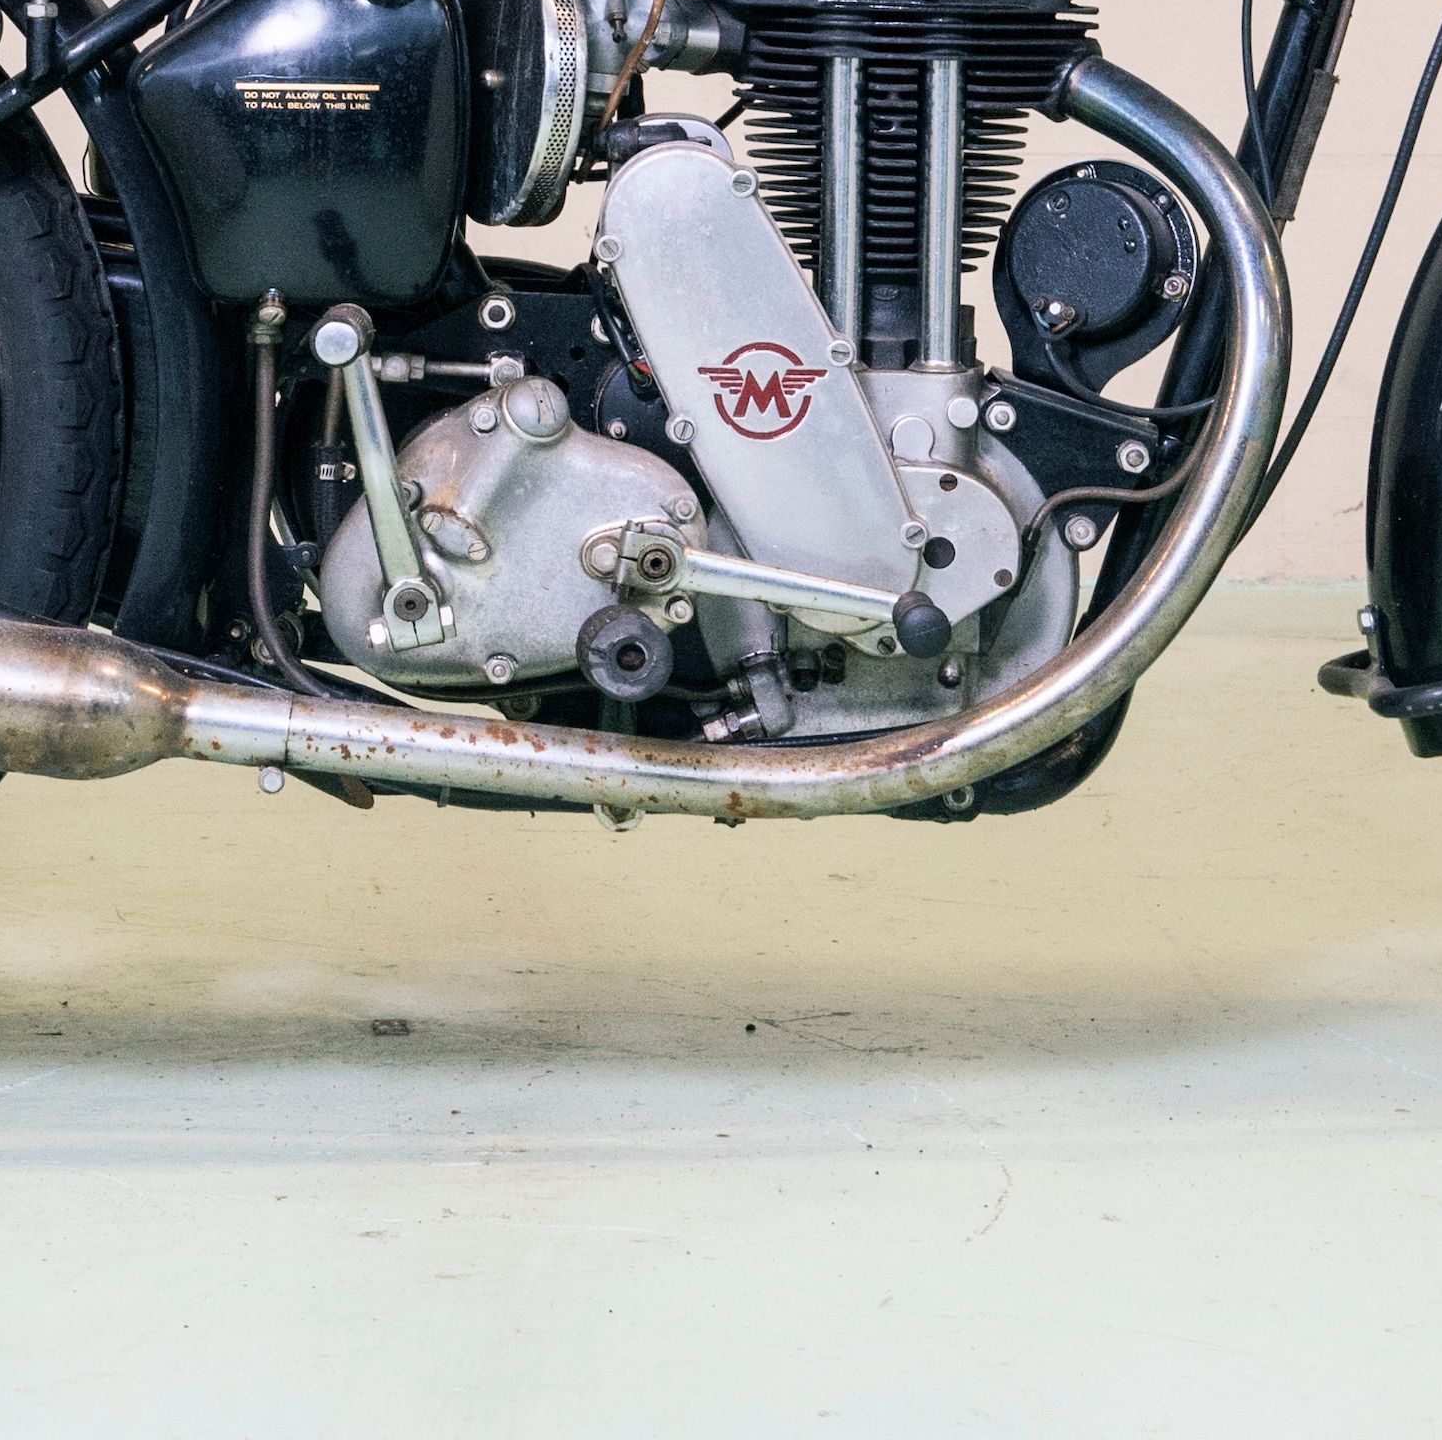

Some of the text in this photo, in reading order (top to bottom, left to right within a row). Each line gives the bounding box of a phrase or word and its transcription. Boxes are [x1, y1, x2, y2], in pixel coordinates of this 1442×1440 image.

[244, 91, 370, 100] DO NOT ALLOW OIL LEVEL
[245, 101, 258, 109] TO
[261, 101, 284, 109] FALL
[287, 102, 321, 110] BELOW
[325, 102, 346, 110] THIS
